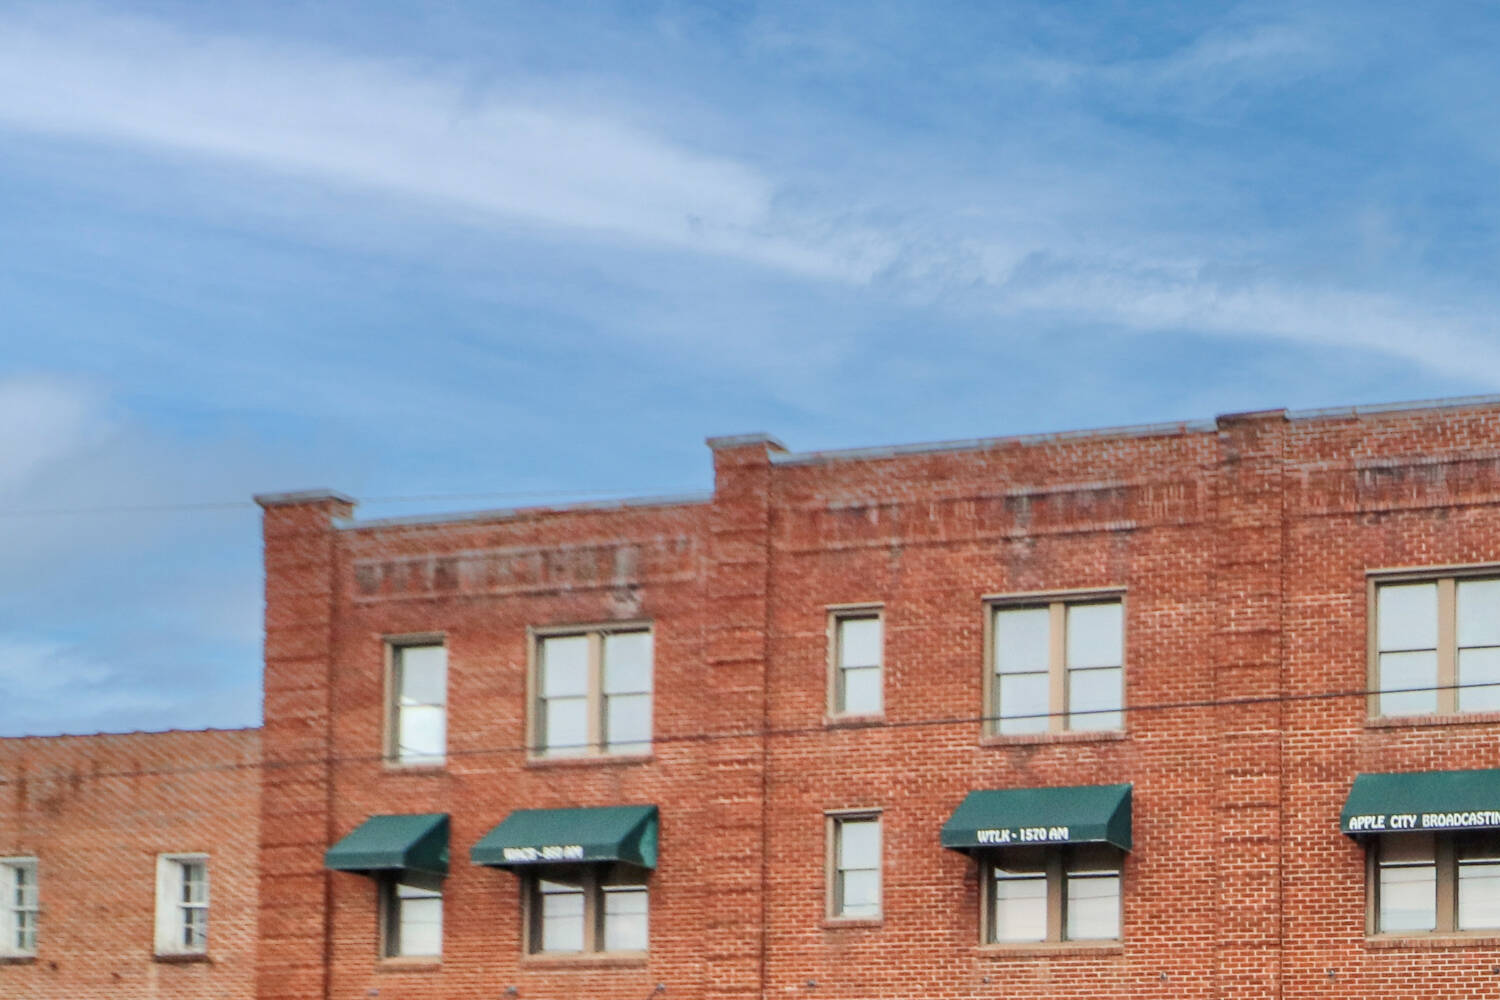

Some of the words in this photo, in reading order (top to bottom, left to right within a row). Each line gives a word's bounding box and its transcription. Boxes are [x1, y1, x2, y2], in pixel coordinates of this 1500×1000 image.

[1350, 814, 1385, 830] APPLE
[1390, 813, 1417, 828] CITY
[977, 829, 1011, 844] WTLK
[1020, 827, 1048, 842] 1570
[1048, 826, 1068, 841] AM
